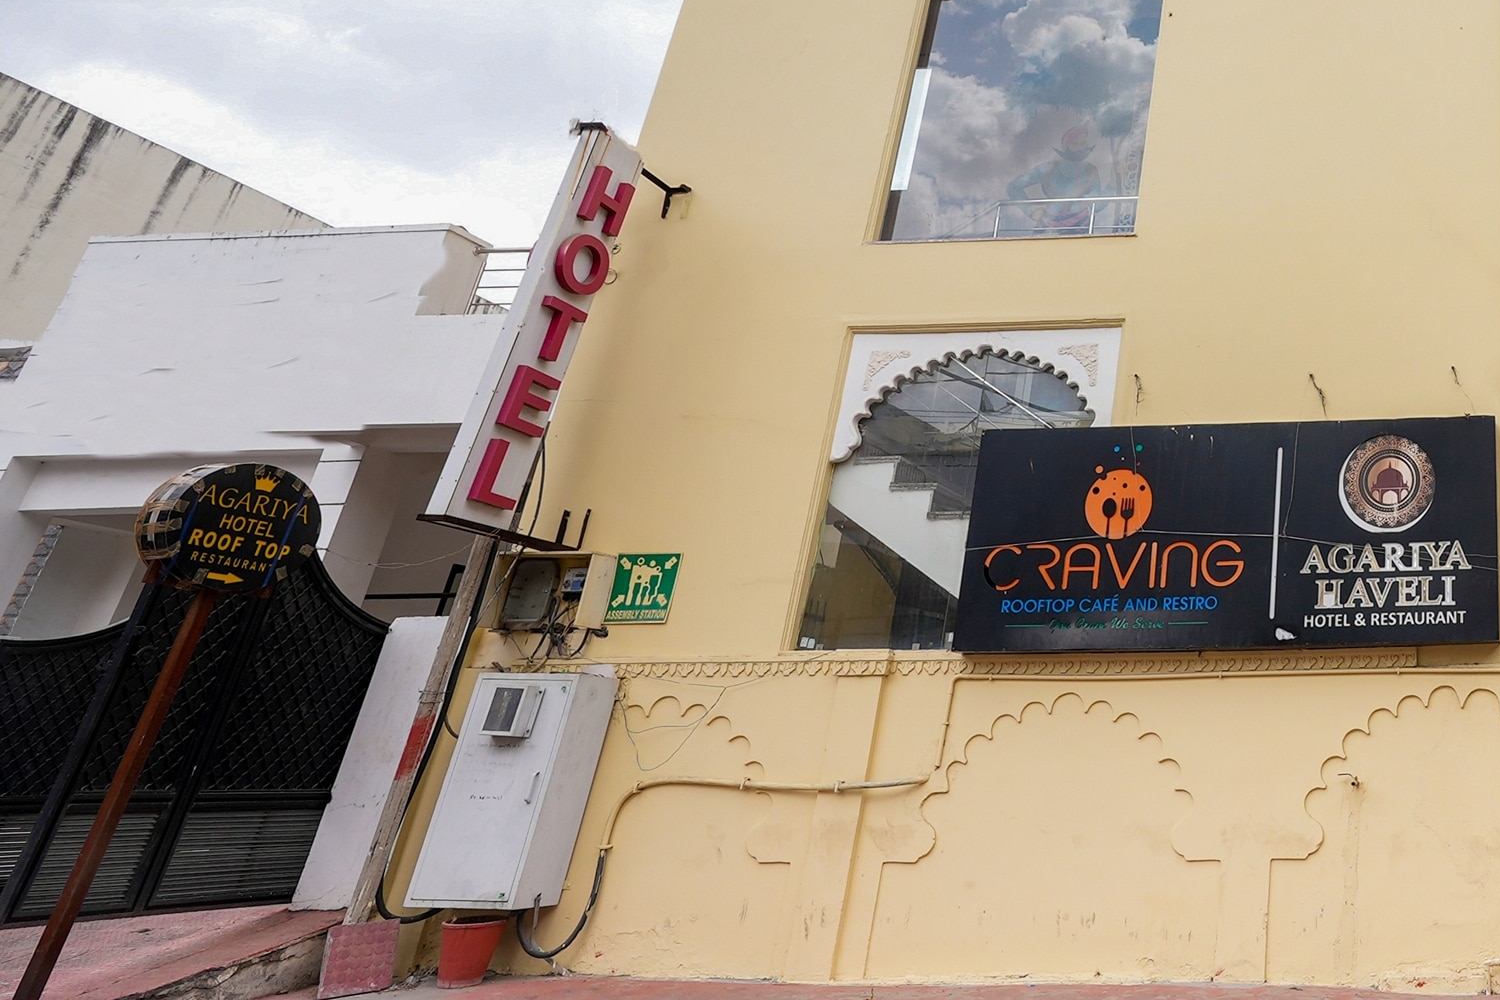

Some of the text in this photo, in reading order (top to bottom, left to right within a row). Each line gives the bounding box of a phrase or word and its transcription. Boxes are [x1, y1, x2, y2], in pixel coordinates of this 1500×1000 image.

[467, 165, 635, 510] HOTEL
[198, 483, 309, 525] AGARIYA
[219, 513, 275, 539] HOTEL
[188, 528, 291, 561] ROOF TOP
[1300, 539, 1472, 574] AGARIYA
[190, 550, 273, 573] RESTAURAN
[983, 540, 1245, 592] CRAVING
[1001, 594, 1218, 614] ROOFTOP CAFÉ AND RESTRO
[1314, 576, 1456, 609] HAVELI
[605, 609, 667, 620] ASSEMBLY STATION
[1111, 617, 1129, 629] We
[1303, 611, 1467, 628] HOTEL & RESTAURANT
